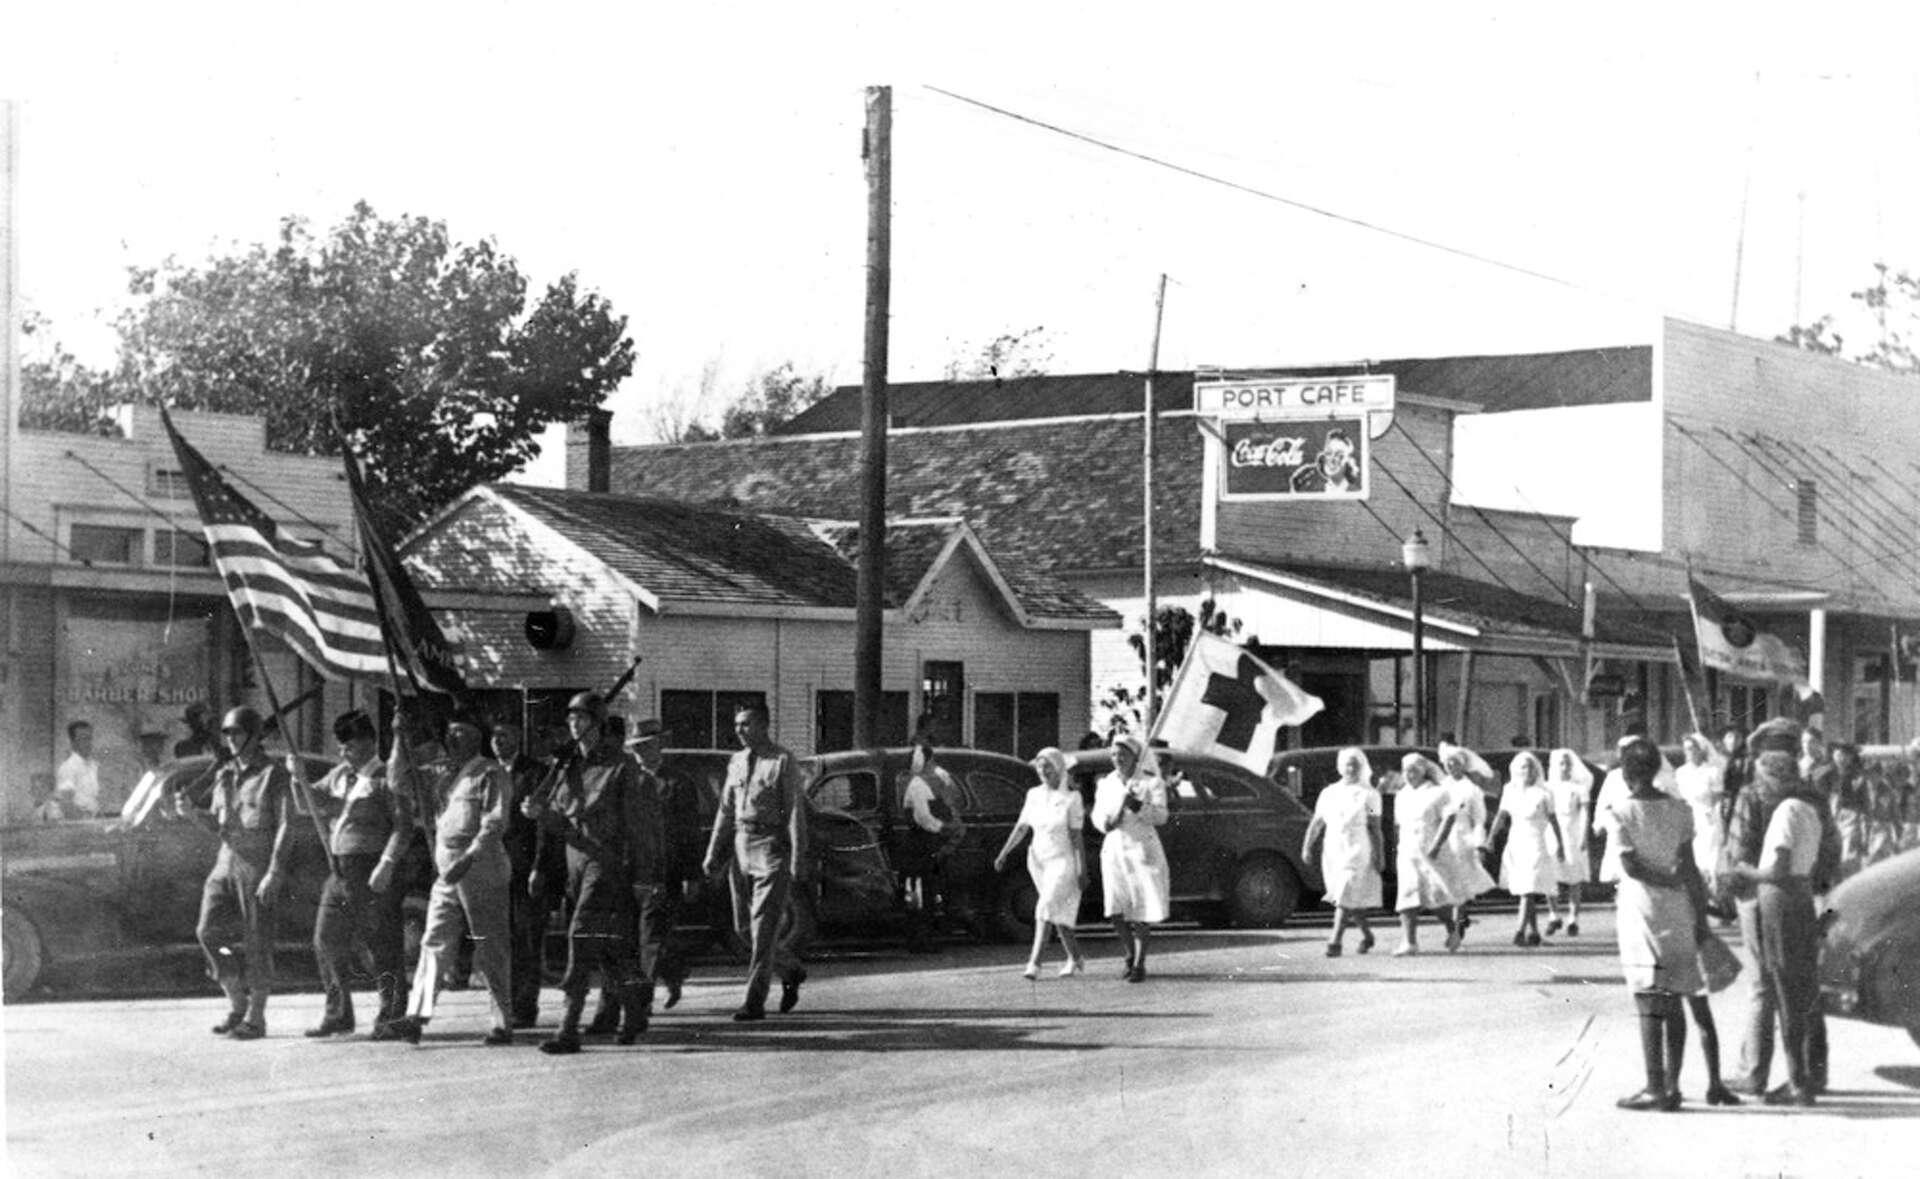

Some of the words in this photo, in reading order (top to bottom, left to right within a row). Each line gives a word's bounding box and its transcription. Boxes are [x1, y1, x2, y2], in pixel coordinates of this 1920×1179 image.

[1223, 387, 1286, 407] PORT
[1300, 384, 1365, 404] CAFE
[67, 687, 150, 702] BARBER
